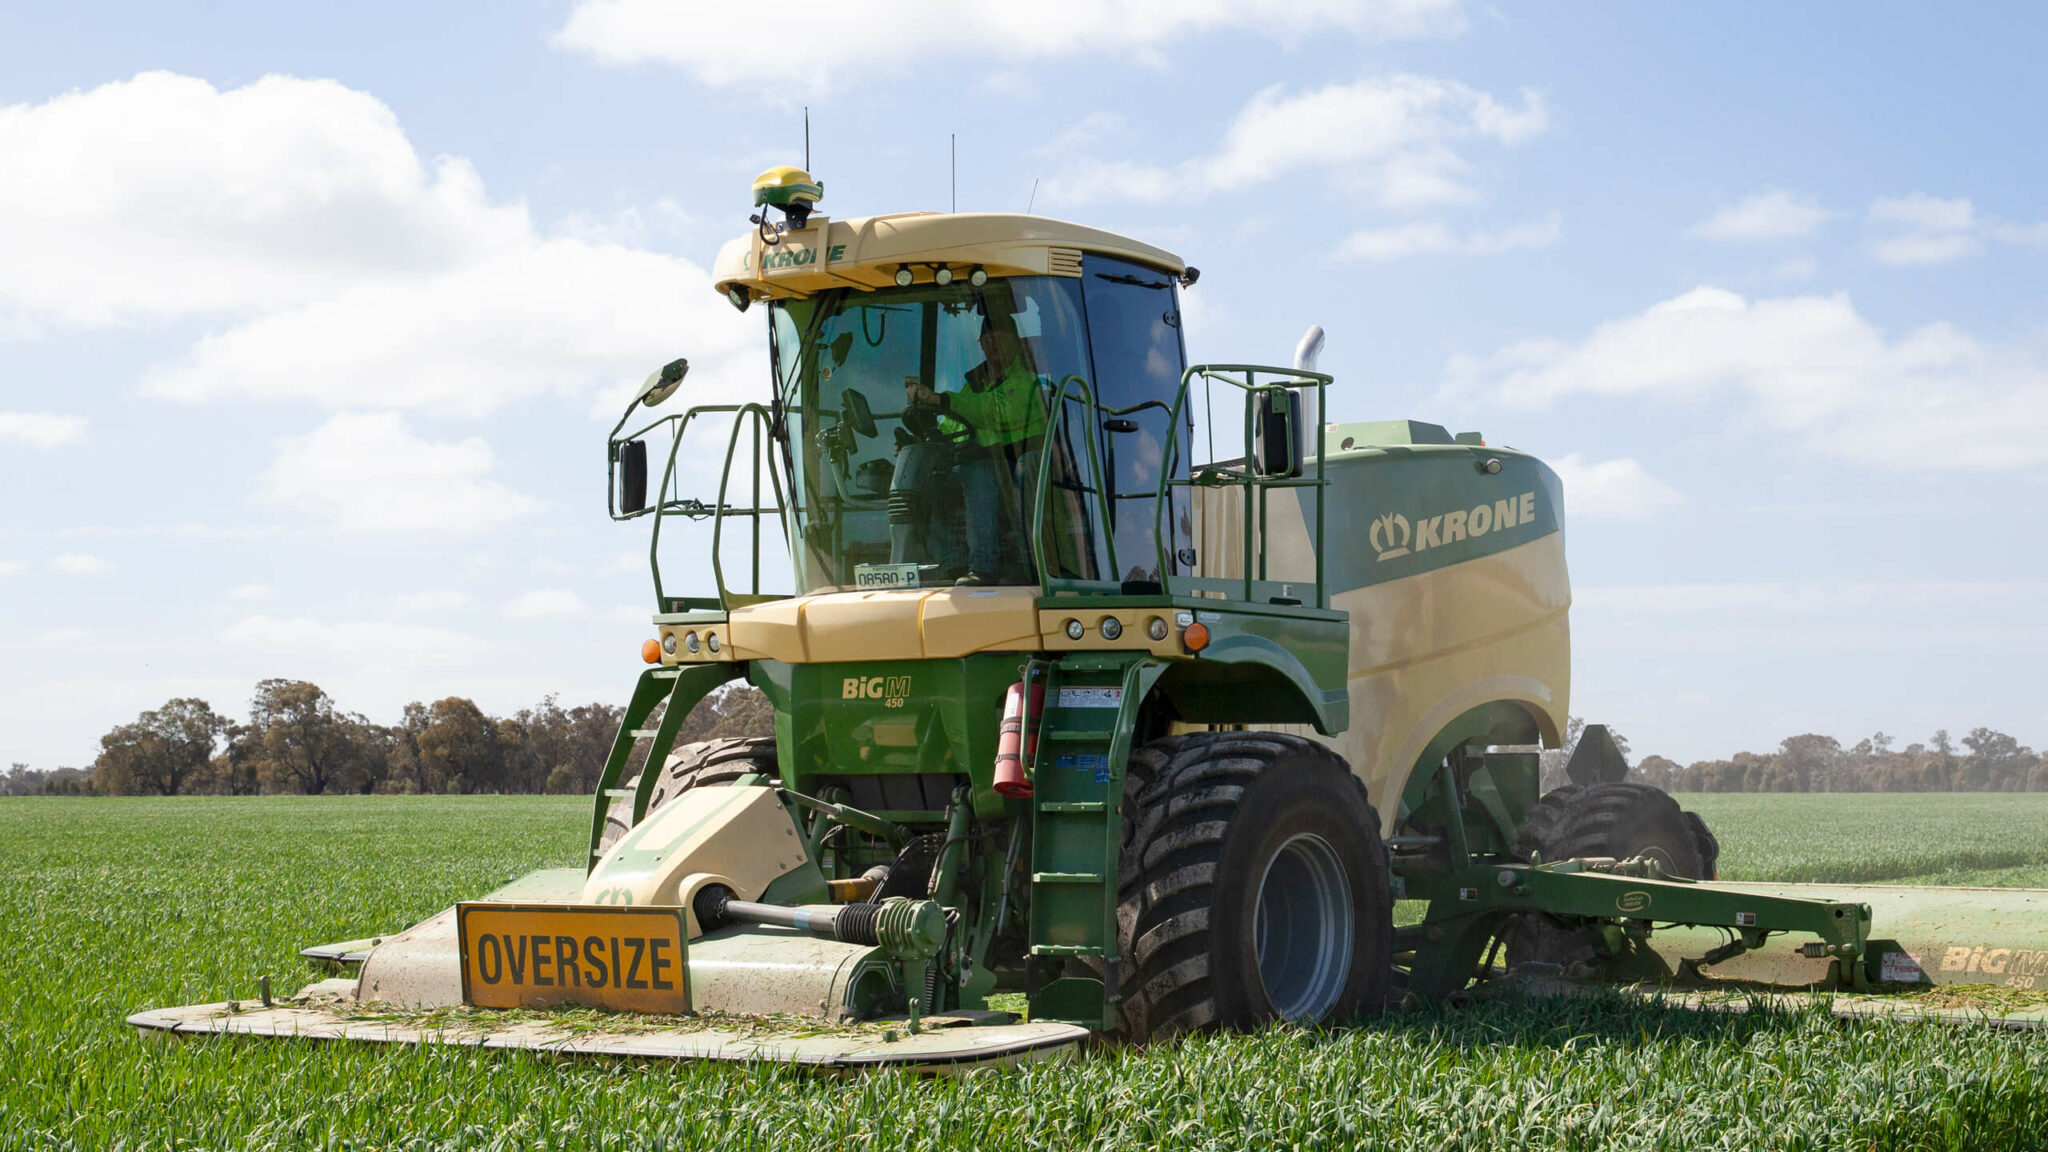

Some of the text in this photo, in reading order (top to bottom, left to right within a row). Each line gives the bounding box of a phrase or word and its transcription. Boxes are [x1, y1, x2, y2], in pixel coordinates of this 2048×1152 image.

[1415, 491, 1536, 552] KRONE
[884, 698, 904, 708] 450
[478, 933, 674, 991] OVERSIZE
[2005, 976, 2035, 989] 450
